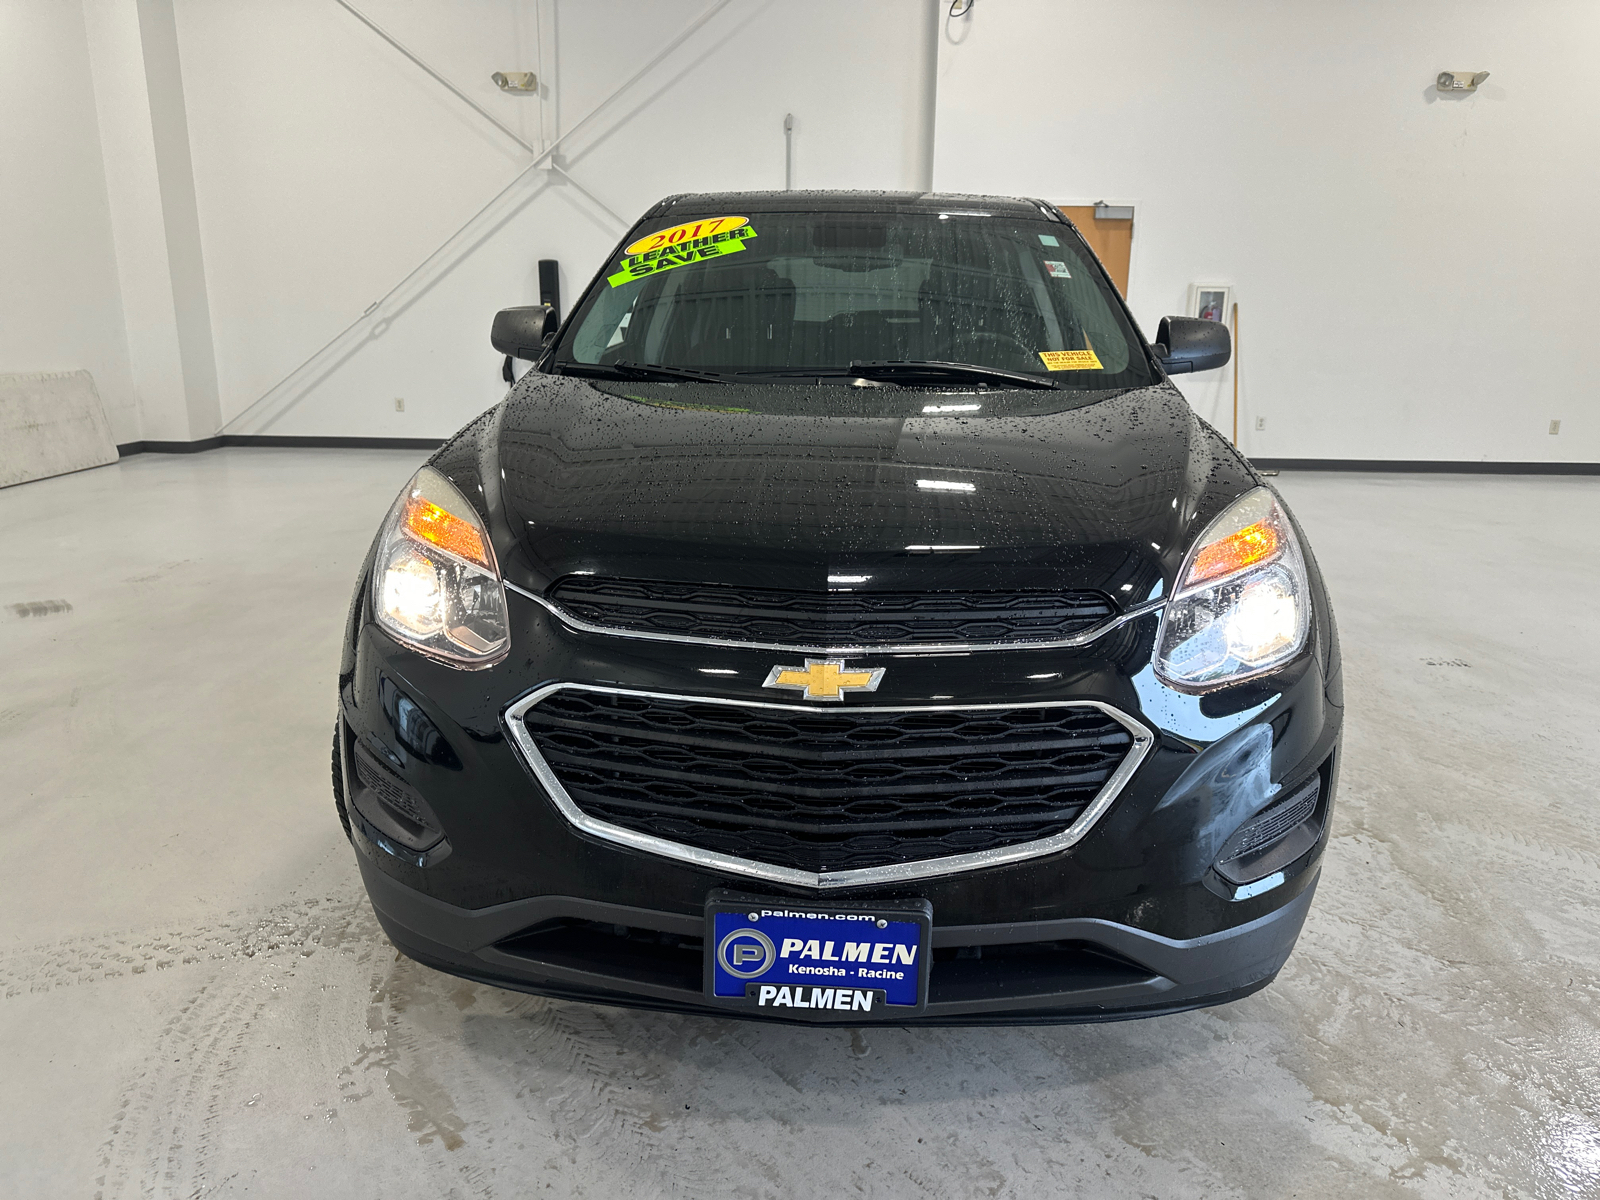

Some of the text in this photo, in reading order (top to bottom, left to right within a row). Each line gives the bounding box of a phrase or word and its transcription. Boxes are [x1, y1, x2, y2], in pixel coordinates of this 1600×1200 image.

[628, 228, 749, 267] LEATHER
[648, 218, 725, 250] 2017
[629, 245, 723, 277] SAVE
[761, 909, 876, 922] palmen.com
[733, 944, 764, 965] P
[780, 938, 917, 965] PALMEN
[788, 963, 846, 977] Kenosha
[858, 968, 904, 980] Racine
[758, 985, 873, 1012] PALMEN
